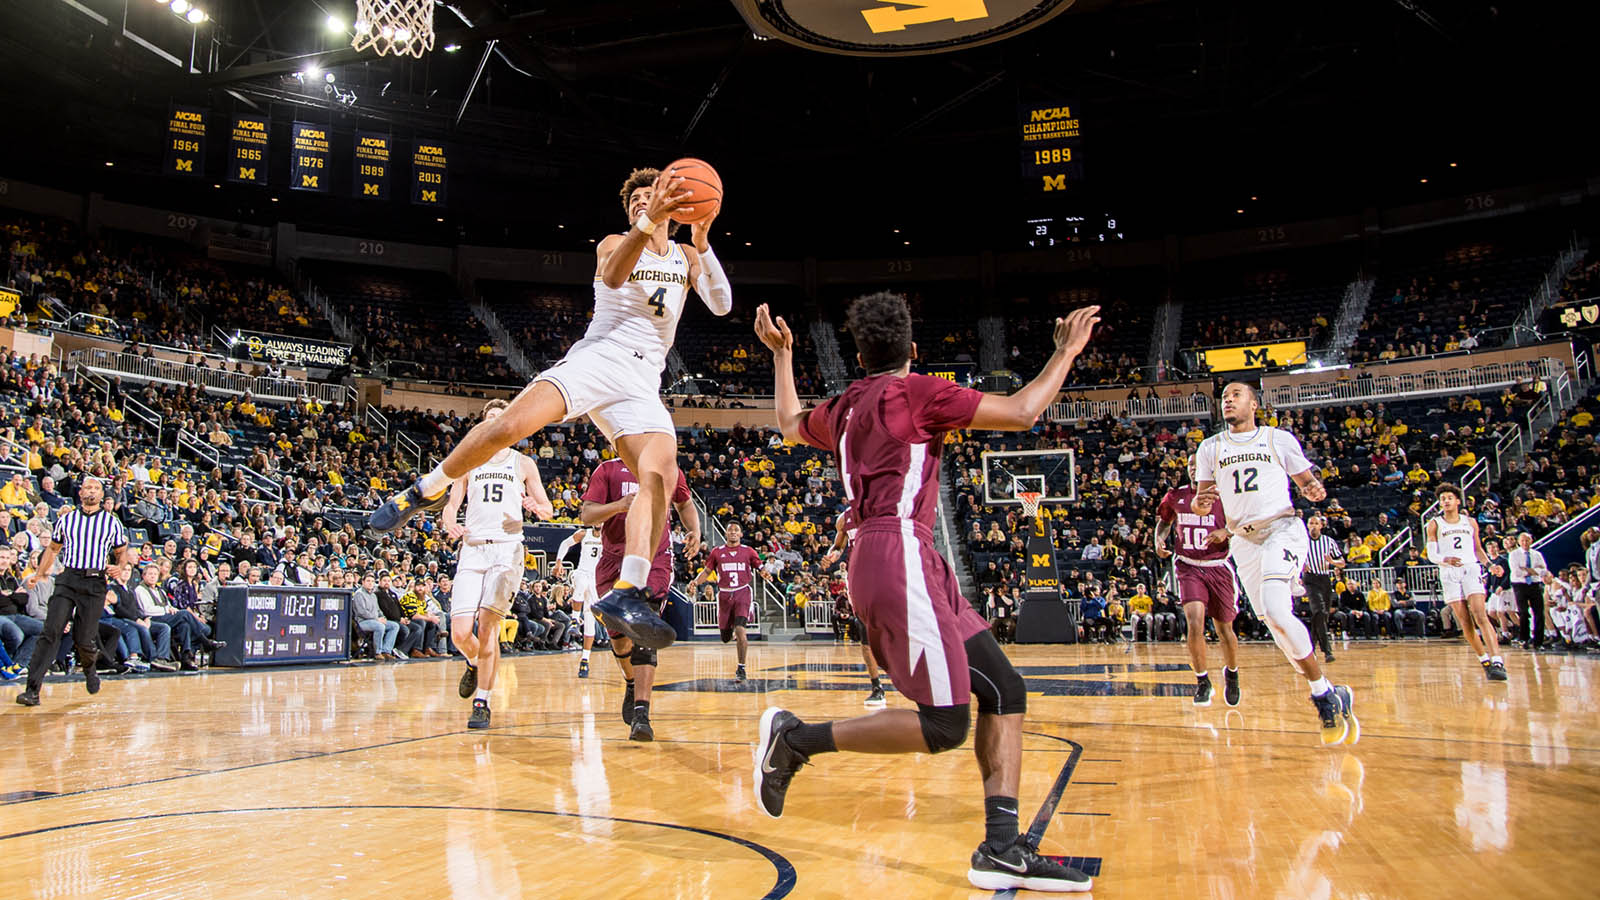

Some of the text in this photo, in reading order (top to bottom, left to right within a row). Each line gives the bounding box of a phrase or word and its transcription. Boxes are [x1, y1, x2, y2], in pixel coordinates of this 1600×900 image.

[175, 111, 202, 122] NCAA
[1031, 107, 1070, 122] NCAA
[170, 120, 189, 129] FINAL
[238, 120, 264, 131] NCAA
[1024, 119, 1079, 134] CHAMPIONS
[233, 129, 251, 137] FINAL
[299, 128, 325, 140] NCAA
[1042, 130, 1079, 140] BASKETBALL
[173, 139, 199, 152] 1964
[295, 137, 313, 146] FINAL
[360, 137, 386, 148] NCAA
[237, 148, 262, 160] 1965
[356, 146, 374, 154] FINAL
[419, 145, 443, 155] NCAA
[1034, 148, 1072, 165] 1989
[299, 156, 324, 168] 1976
[414, 153, 431, 162] FINAL
[175, 158, 193, 172] M
[360, 164, 384, 176] 1989
[239, 166, 256, 180] M
[418, 171, 441, 184] 2013
[302, 174, 319, 188] M
[1042, 174, 1066, 192] M
[363, 183, 379, 196] M
[422, 189, 437, 202] M
[1464, 195, 1496, 209] 216
[168, 214, 198, 229] 209
[1035, 225, 1048, 236] 23
[359, 241, 385, 255] 210
[627, 270, 688, 285] MICHIGAN
[647, 286, 667, 317] 4
[265, 340, 304, 353] ALWAYS
[265, 348, 307, 361] FOREER
[1243, 347, 1269, 367] M
[1218, 452, 1272, 469] MICHIGAN
[474, 472, 514, 483] MICHIGAN
[1231, 467, 1259, 495] 12
[482, 483, 504, 503] 15
[1182, 527, 1209, 551] 10
[1453, 536, 1462, 550] 2
[590, 547, 599, 557] 3
[1031, 553, 1051, 568] M
[729, 571, 739, 587] 3
[284, 595, 315, 617] 10:22
[255, 614, 269, 631] 23
[329, 614, 339, 630] 13
[245, 640, 252, 655] 4
[267, 639, 275, 655] 3
[295, 639, 301, 653] 1
[319, 638, 326, 653] 5
[336, 638, 343, 652] 4
